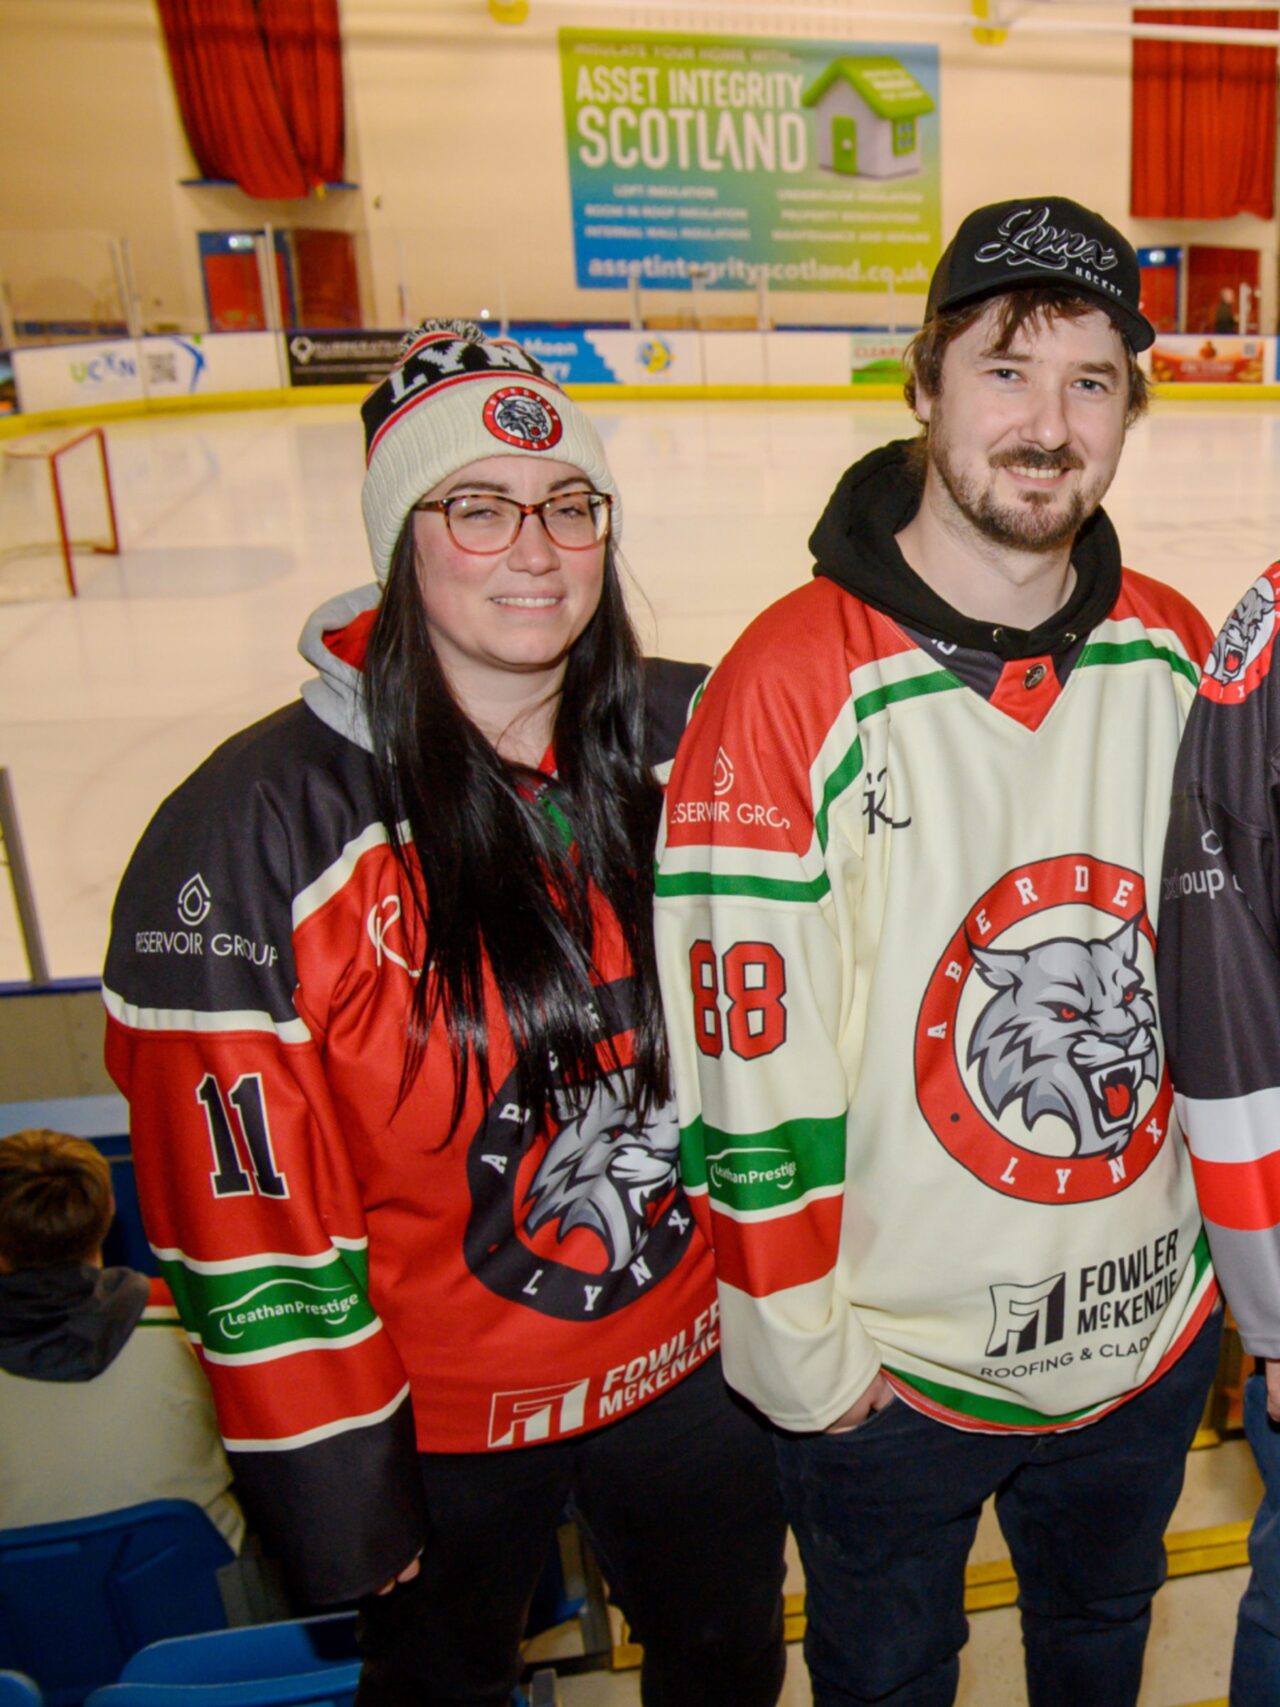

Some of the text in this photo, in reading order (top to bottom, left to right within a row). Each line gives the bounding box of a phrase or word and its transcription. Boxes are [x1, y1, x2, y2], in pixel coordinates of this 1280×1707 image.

[576, 64, 804, 110] ASSET INTEGRITY
[578, 106, 807, 173] SCOTLAND
[588, 253, 930, 285] assetintegrityscotland.co.uk
[1074, 266, 1123, 297] HOCKEY
[135, 931, 279, 967] RESERVOIR GROUP
[927, 864, 1134, 1040] ABERDE
[689, 938, 787, 1062] 88
[195, 1072, 290, 1199] 11
[1001, 1117, 1163, 1194] LYNX
[523, 1208, 691, 1312] LYNX
[1079, 1228, 1179, 1302] FOWLER
[980, 1332, 1157, 1378] ROOFING & CLAD
